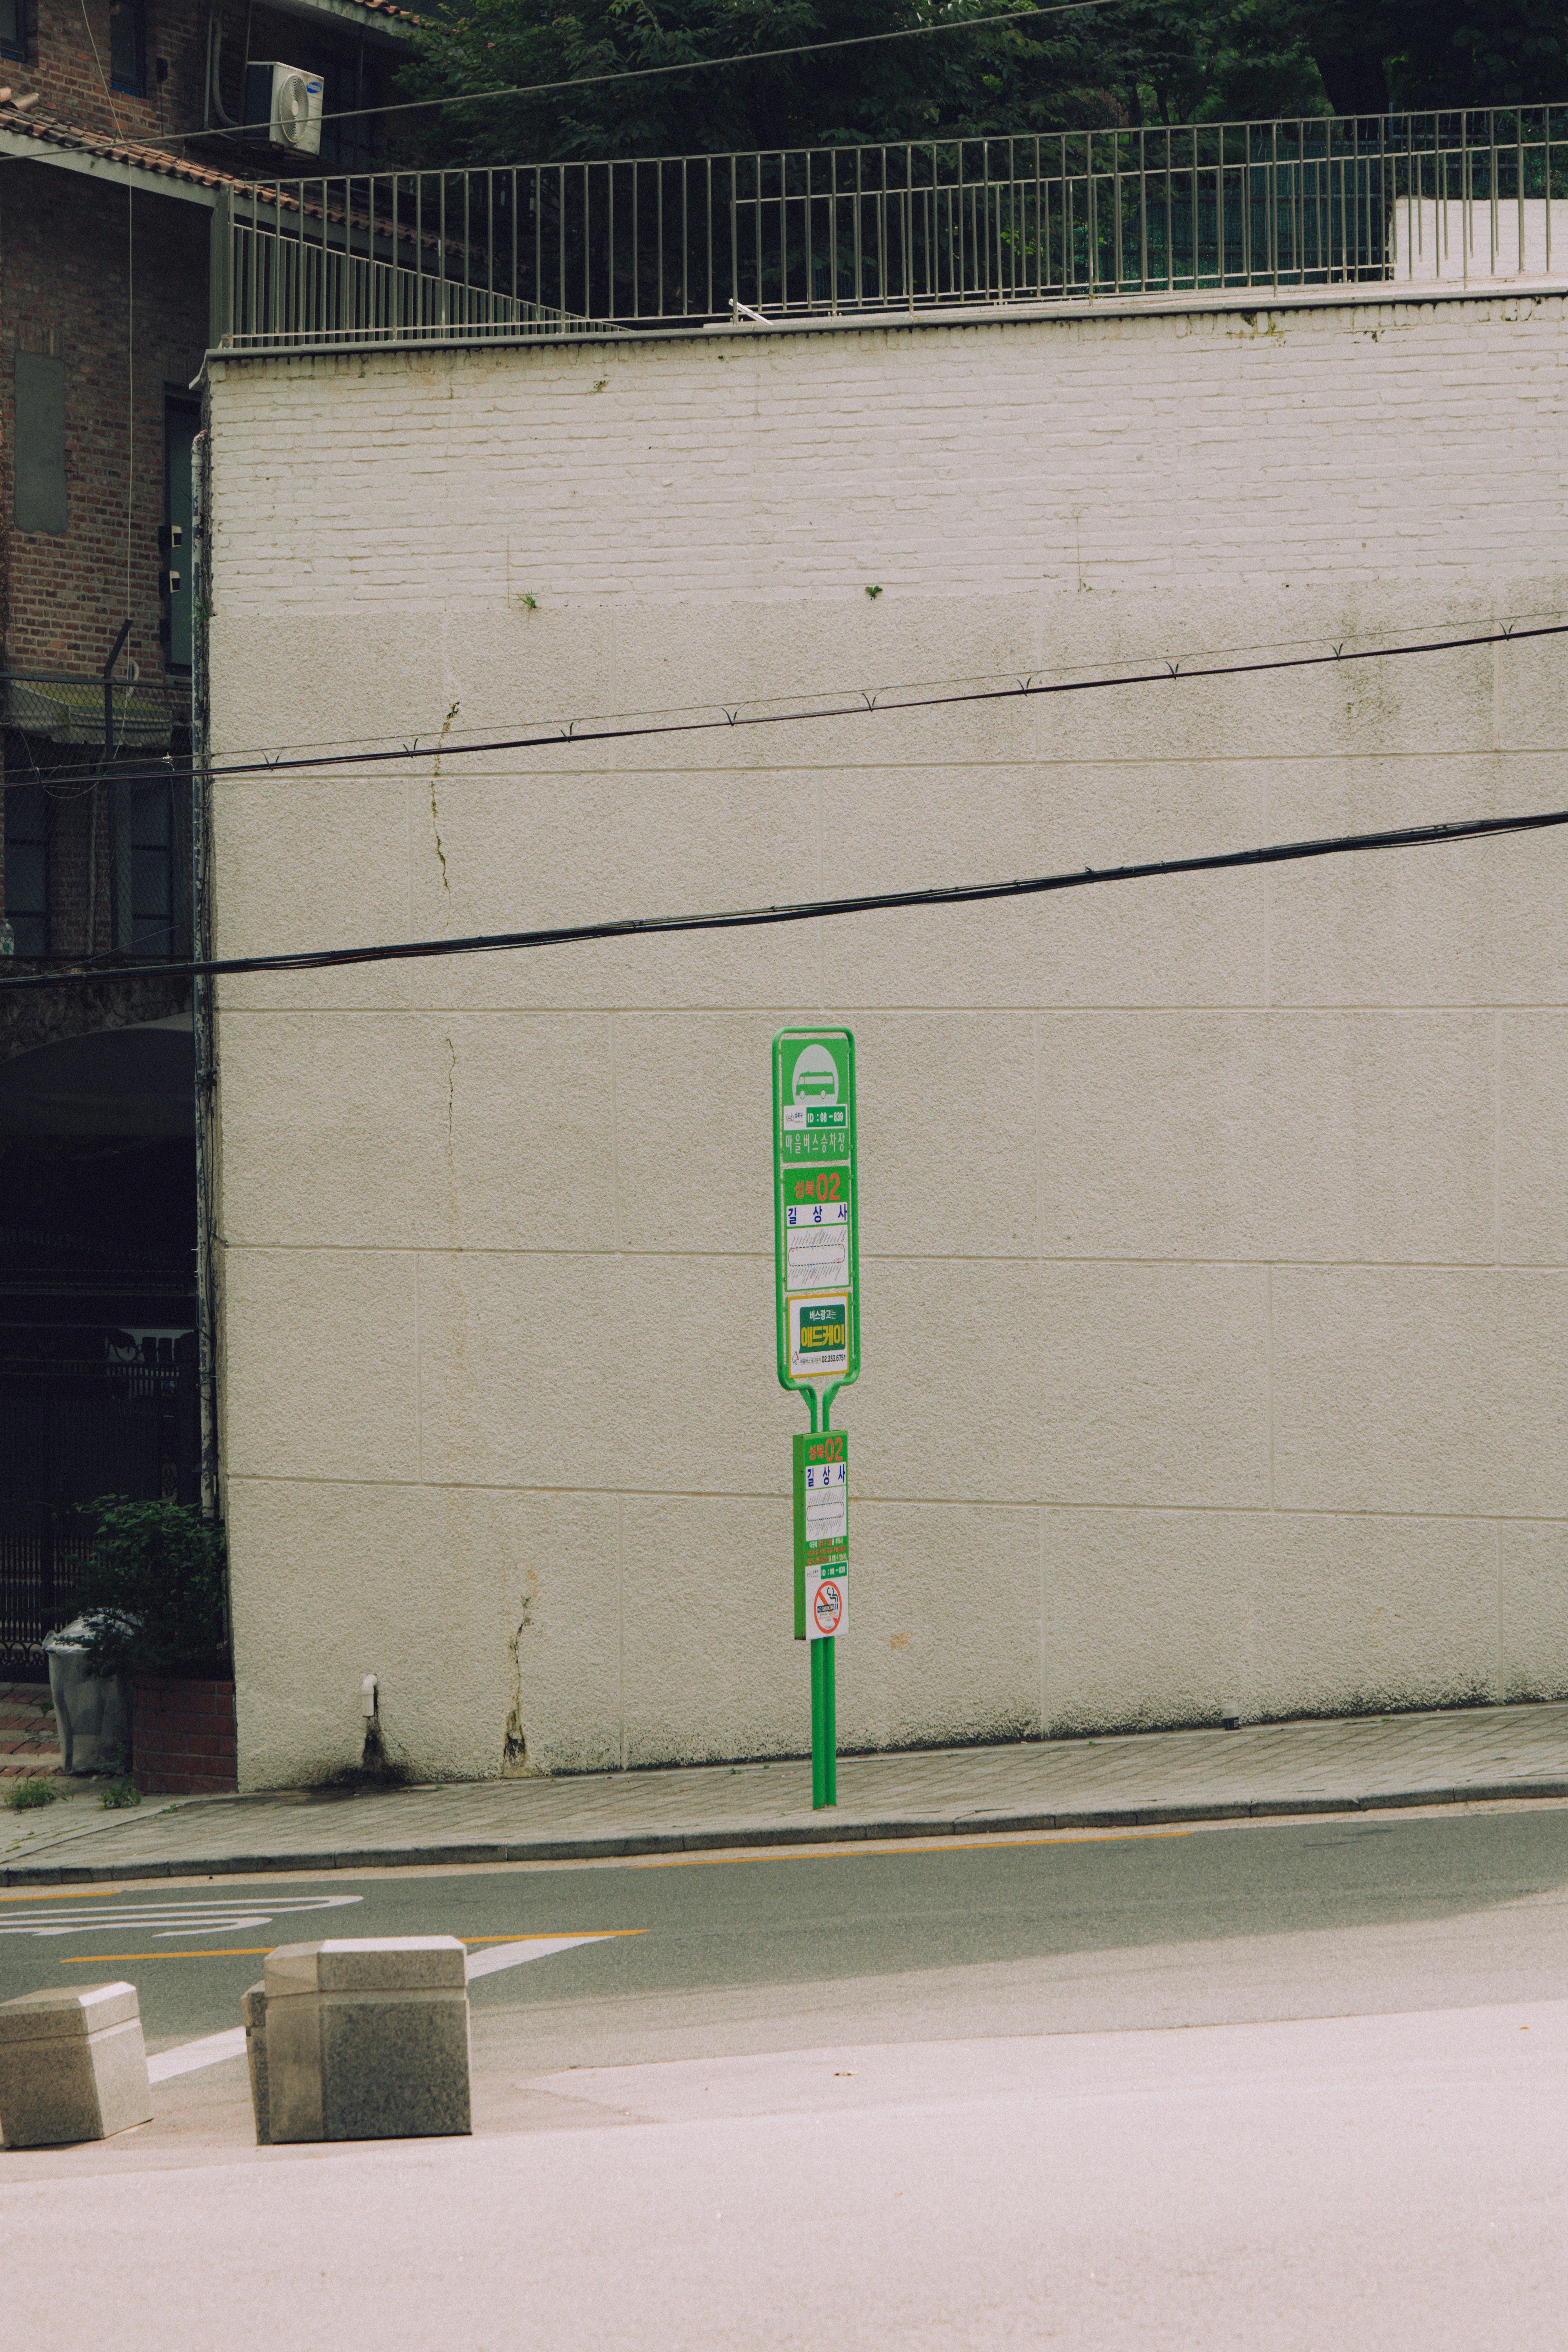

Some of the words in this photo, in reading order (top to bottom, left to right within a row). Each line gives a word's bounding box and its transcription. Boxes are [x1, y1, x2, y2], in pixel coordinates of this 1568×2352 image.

[808, 1113, 814, 1123] ID
[786, 1132, 845, 1154] 마을버스승차장
[809, 1309, 836, 1321] 버스광고는
[801, 1324, 844, 1348] 애드케이
[822, 1354, 846, 1363] 02.333.6751
